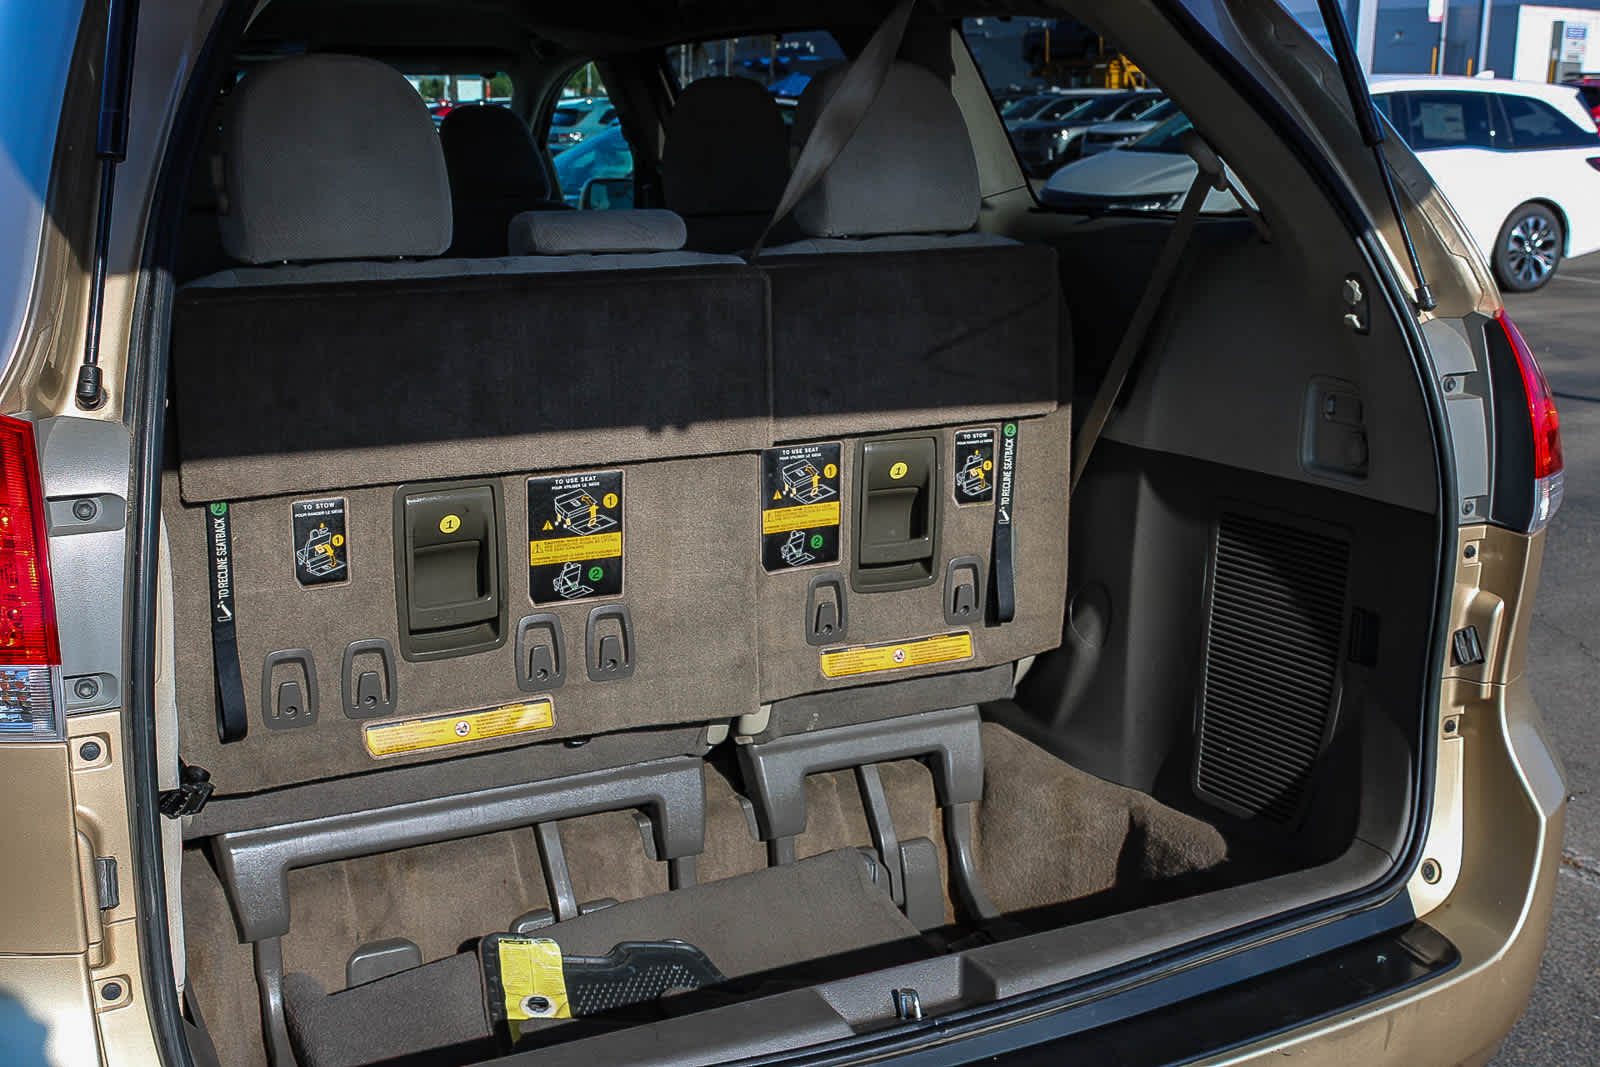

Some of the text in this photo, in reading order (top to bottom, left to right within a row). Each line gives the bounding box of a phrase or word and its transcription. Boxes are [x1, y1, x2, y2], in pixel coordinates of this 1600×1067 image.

[1001, 438, 1014, 505] TO RECLINE SEATBACK
[315, 502, 335, 510] STOW
[214, 517, 230, 600] TO RECLINE SEATBACK
